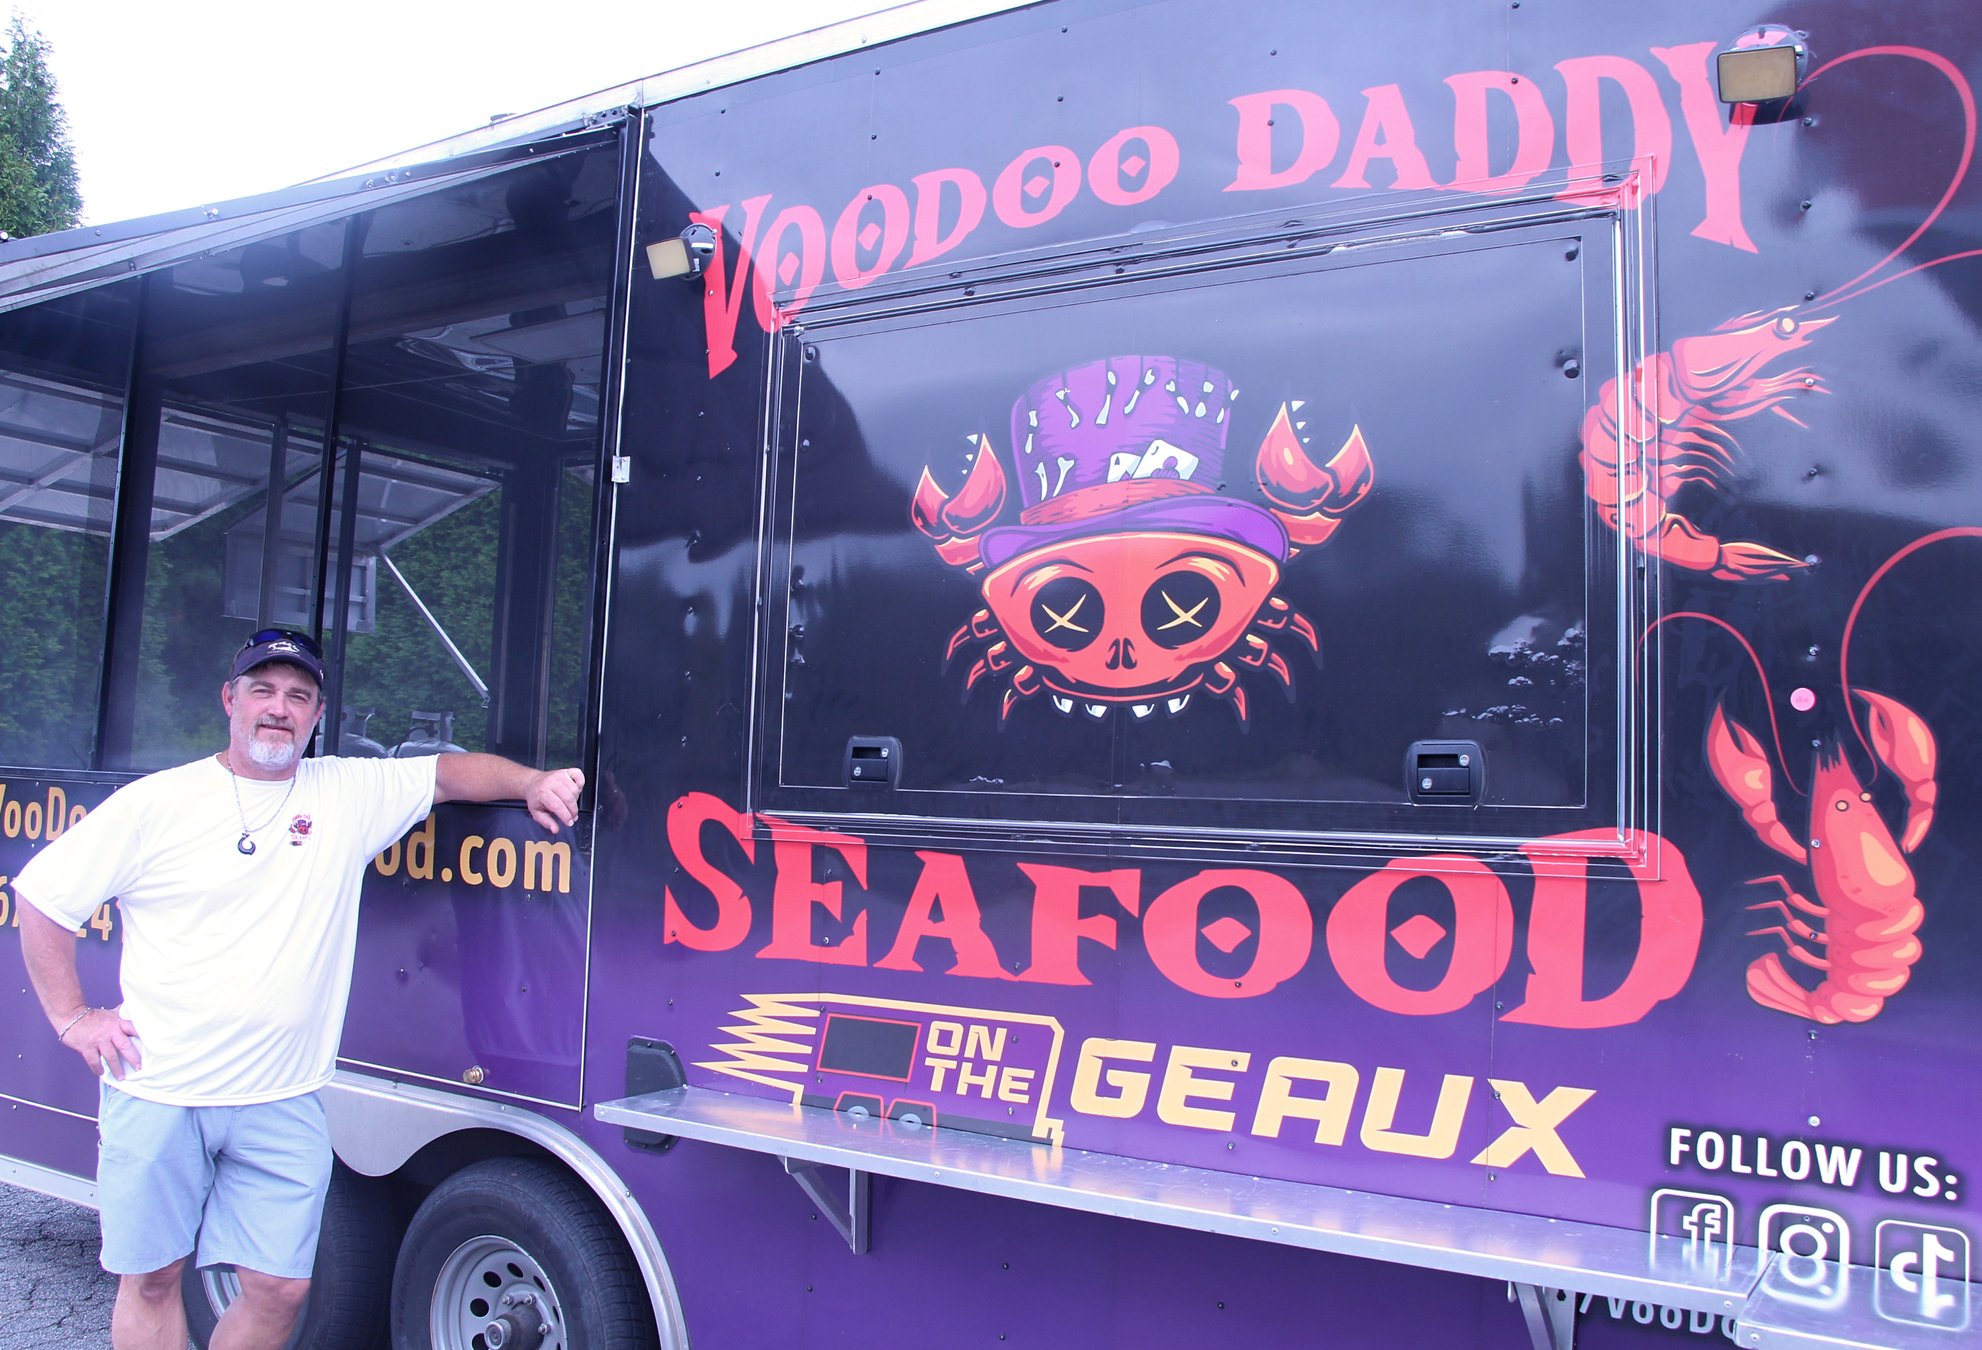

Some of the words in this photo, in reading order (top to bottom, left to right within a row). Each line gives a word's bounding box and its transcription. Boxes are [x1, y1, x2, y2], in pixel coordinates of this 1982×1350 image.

[689, 125, 1180, 380] VOODOO
[1221, 31, 1789, 254] DADDY
[663, 791, 1704, 1030] SEAFOOD
[924, 1057, 1037, 1104] THE
[926, 1020, 1008, 1062] ON
[1070, 1037, 1598, 1179] GEAUX
[1669, 1127, 1863, 1187] FOLLOW
[1878, 1151, 1958, 1201] US:
